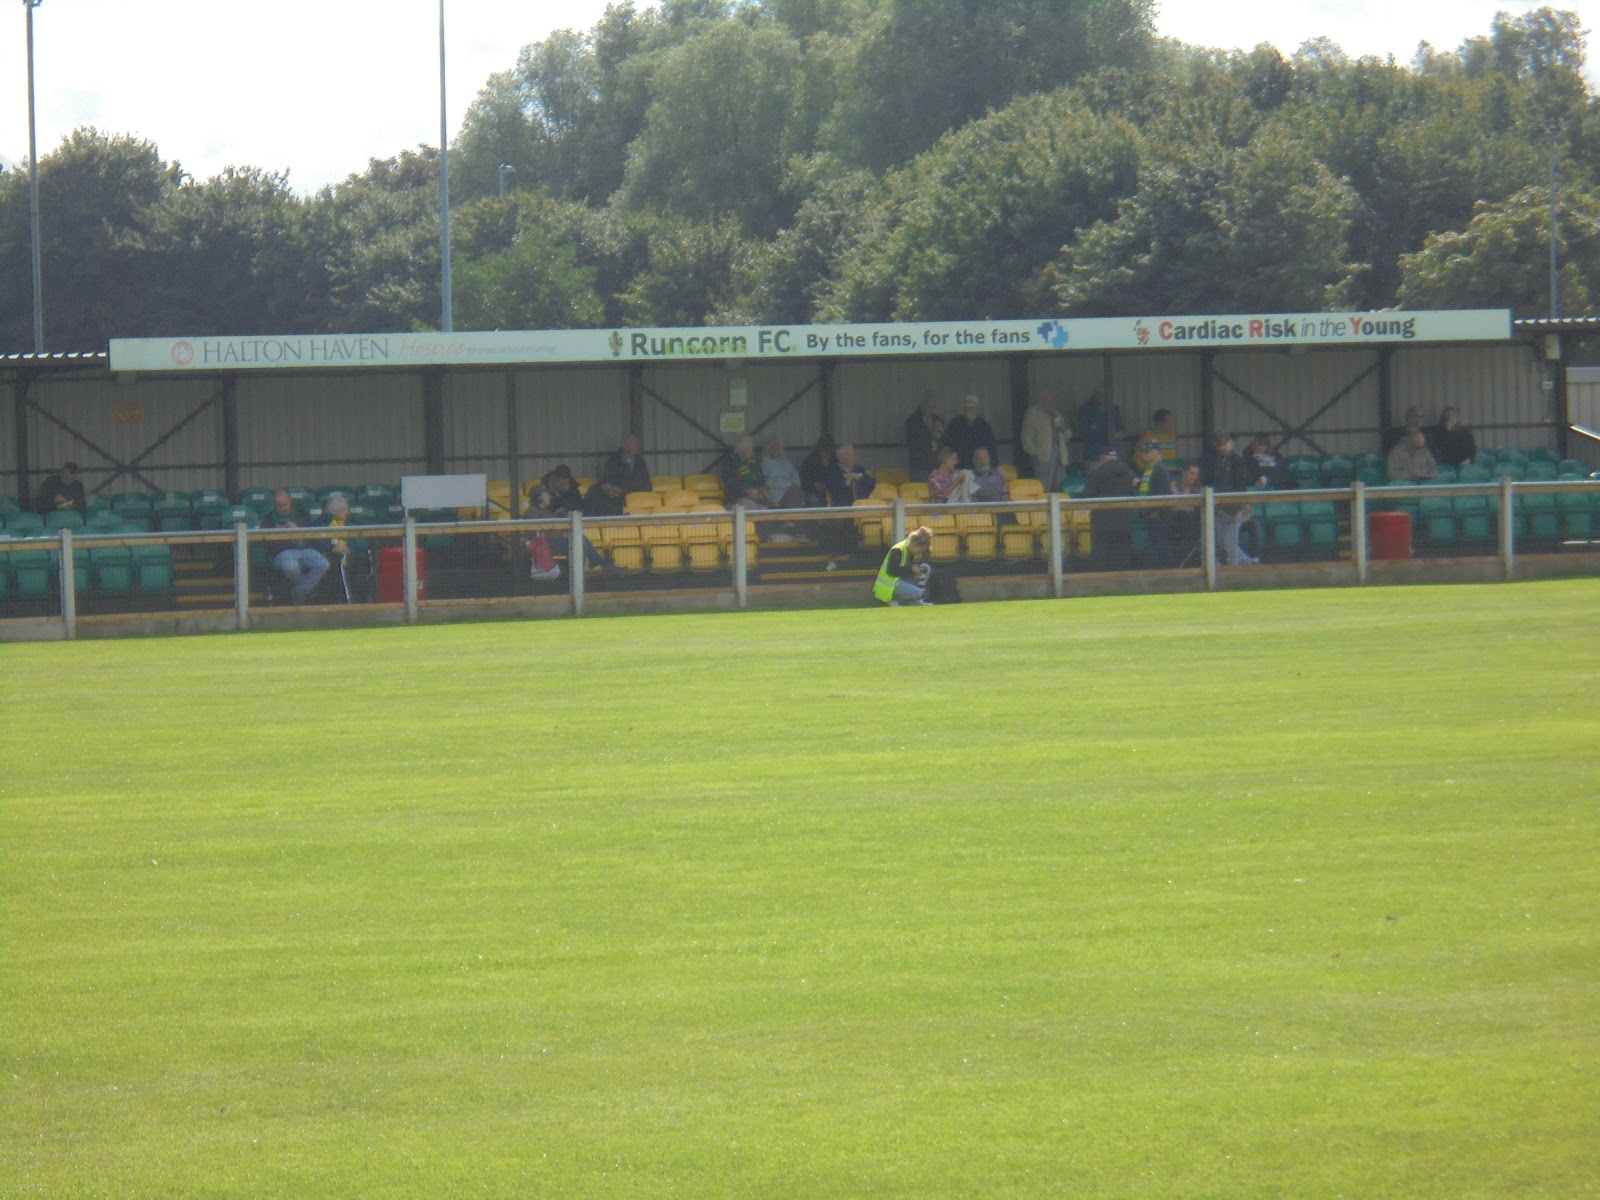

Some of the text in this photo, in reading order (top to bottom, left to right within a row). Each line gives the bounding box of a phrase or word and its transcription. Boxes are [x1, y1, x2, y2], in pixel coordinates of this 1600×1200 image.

[806, 328, 1030, 351] By the fans, for the fans
[1158, 316, 1416, 341] Cardiac Risk in the Young
[203, 340, 302, 363] HALTON
[310, 338, 389, 361] HAVEN
[630, 332, 747, 356] Runcorn
